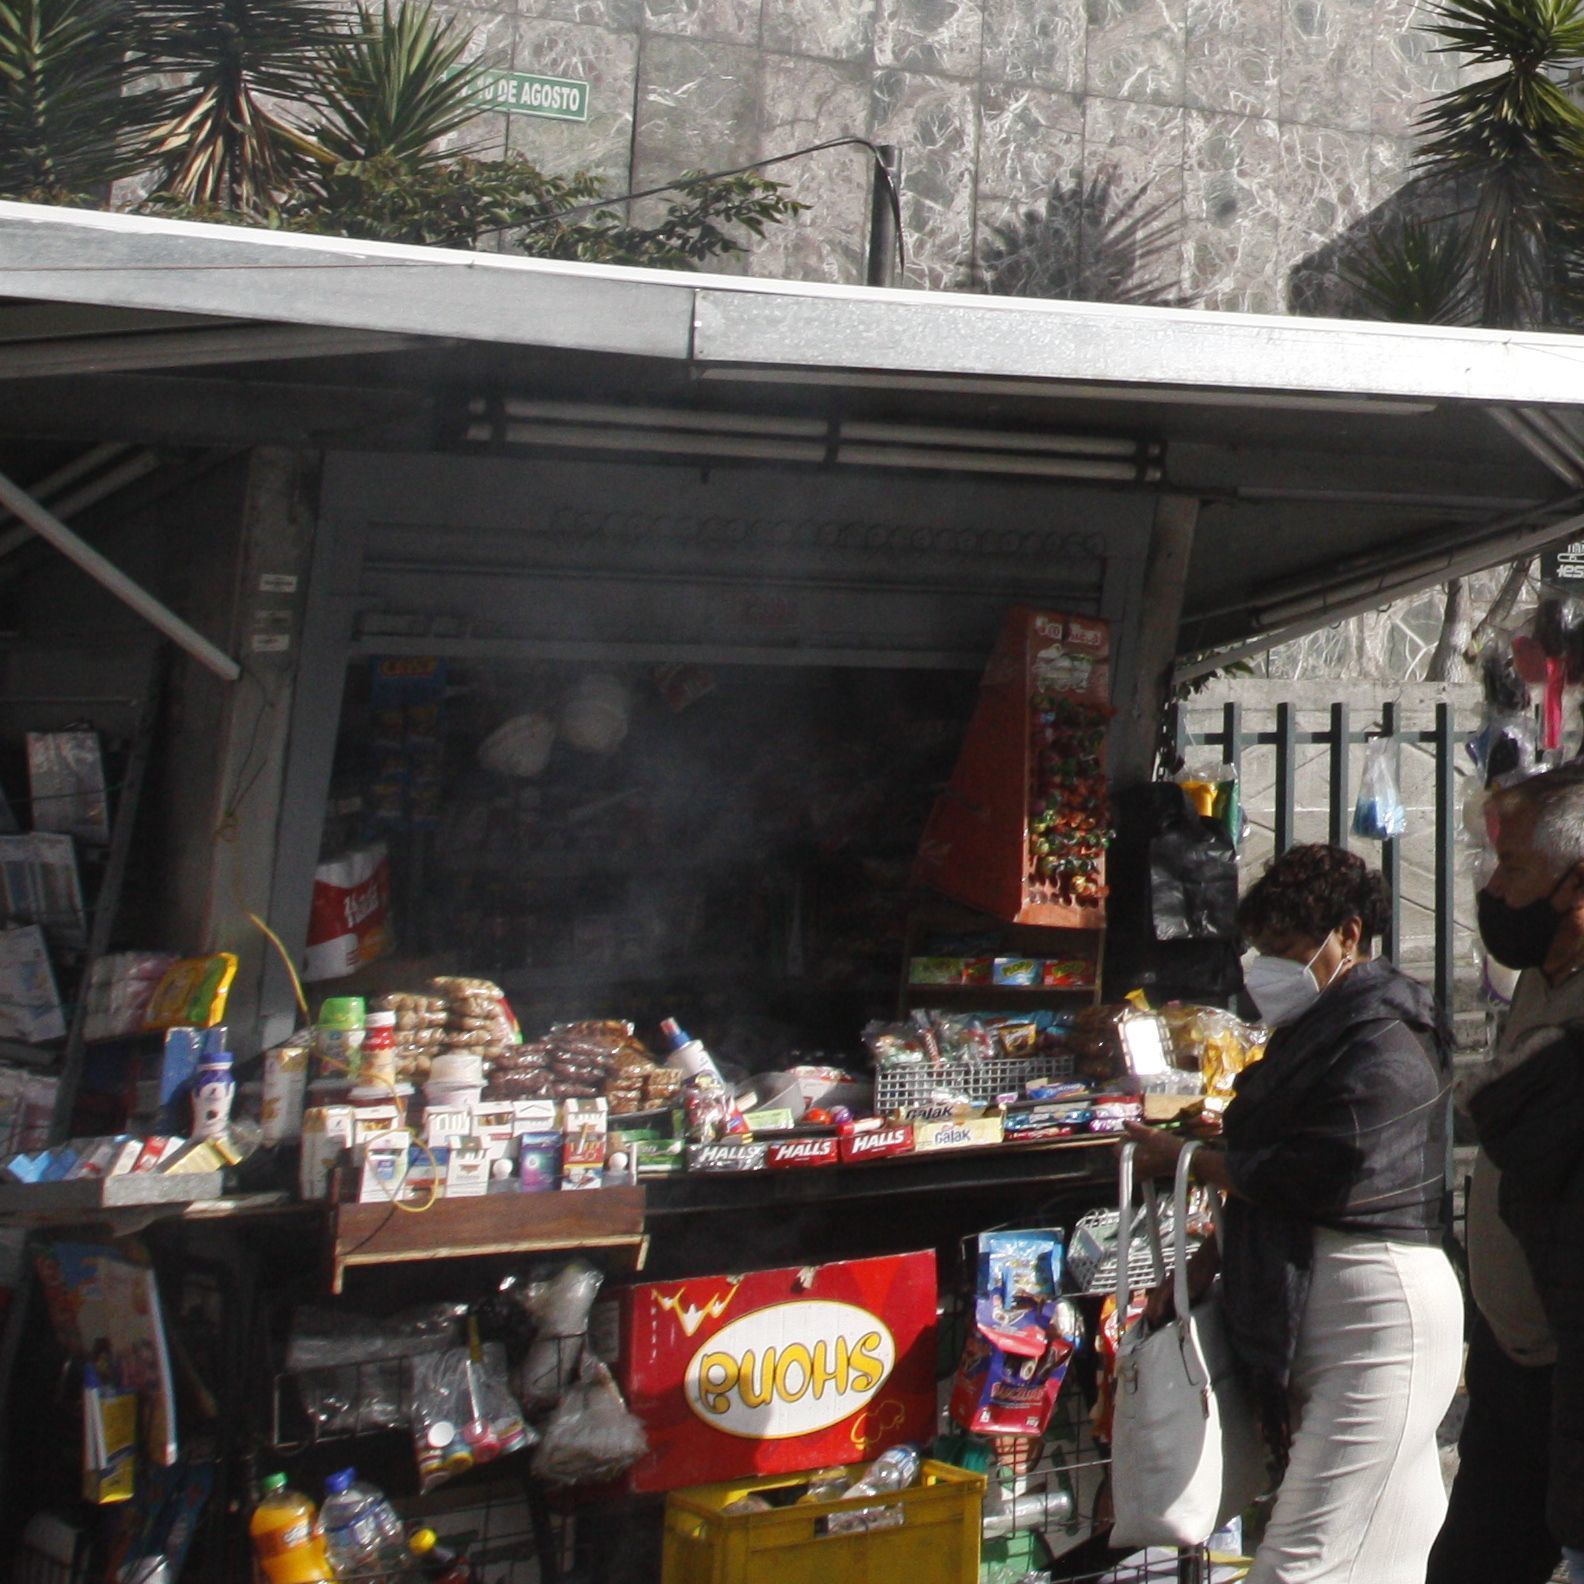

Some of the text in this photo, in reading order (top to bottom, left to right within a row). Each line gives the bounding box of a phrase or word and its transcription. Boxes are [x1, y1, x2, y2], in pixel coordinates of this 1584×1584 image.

[497, 78, 518, 103] DE
[520, 81, 580, 112] AGOSTO
[699, 1142, 757, 1163] HALLS
[775, 1141, 831, 1161] HALLS
[853, 1129, 905, 1154] HALLS
